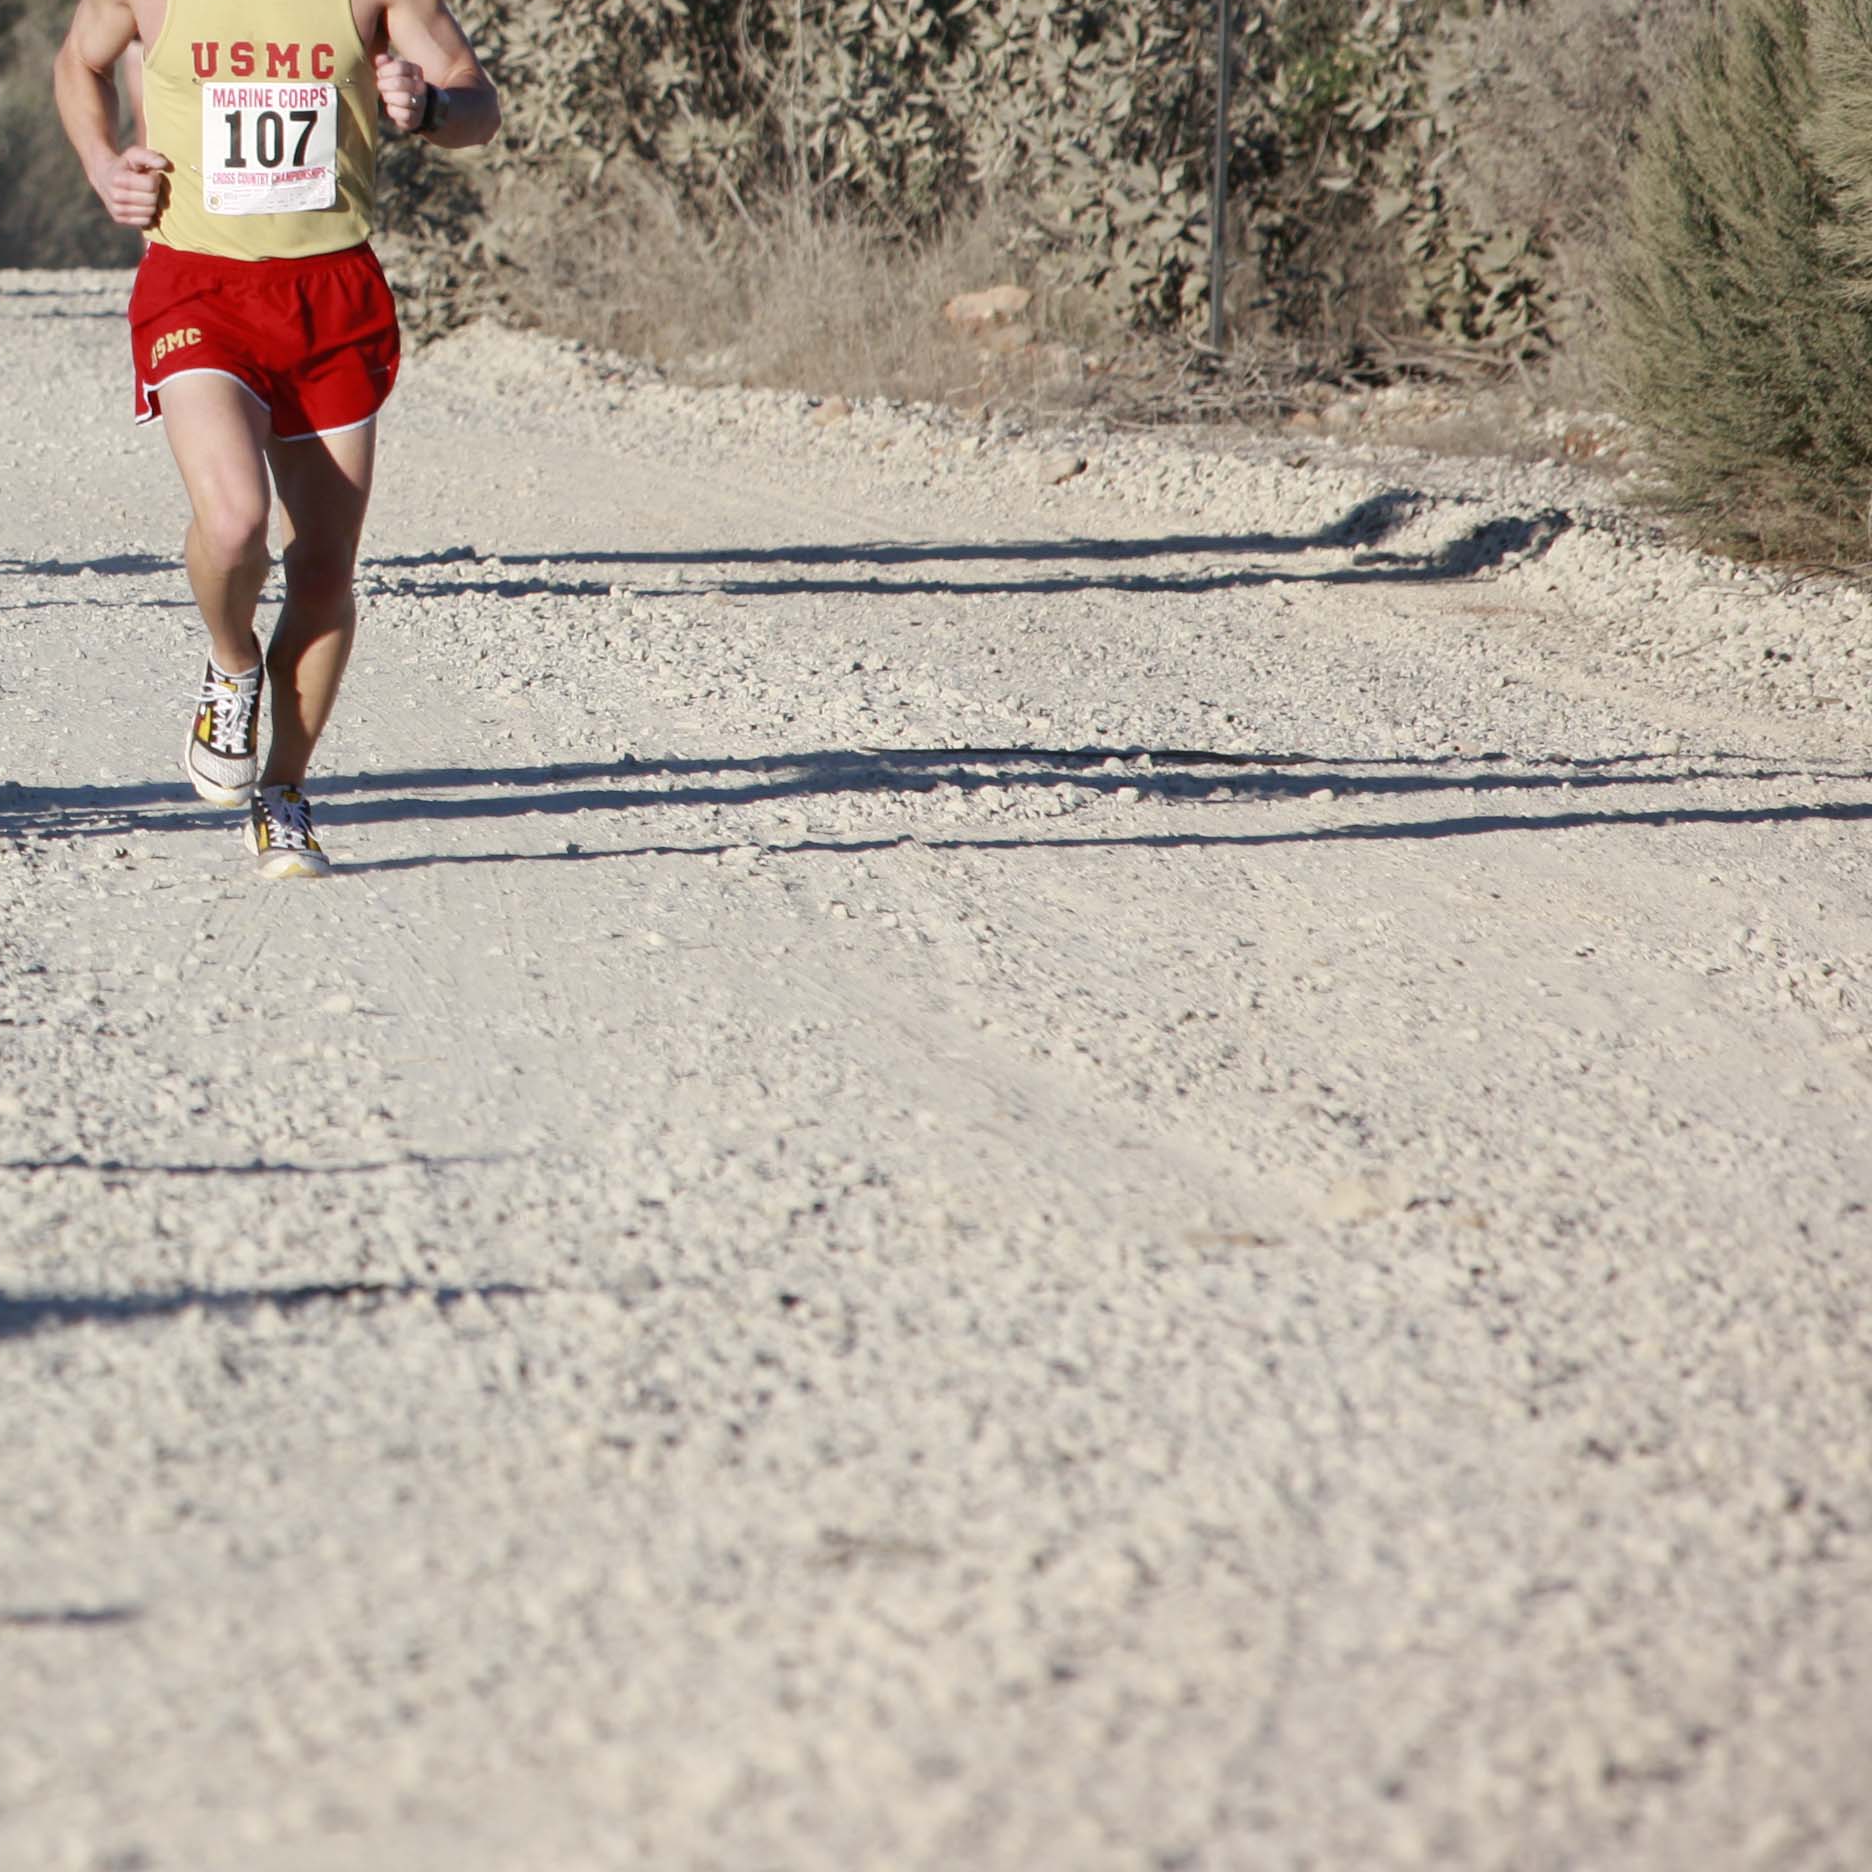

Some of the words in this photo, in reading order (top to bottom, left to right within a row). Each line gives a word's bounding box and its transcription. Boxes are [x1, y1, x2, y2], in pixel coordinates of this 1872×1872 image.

[192, 42, 334, 79] USMC
[212, 88, 273, 108] MARINE
[278, 87, 328, 108] CORPS
[225, 110, 318, 168] 107
